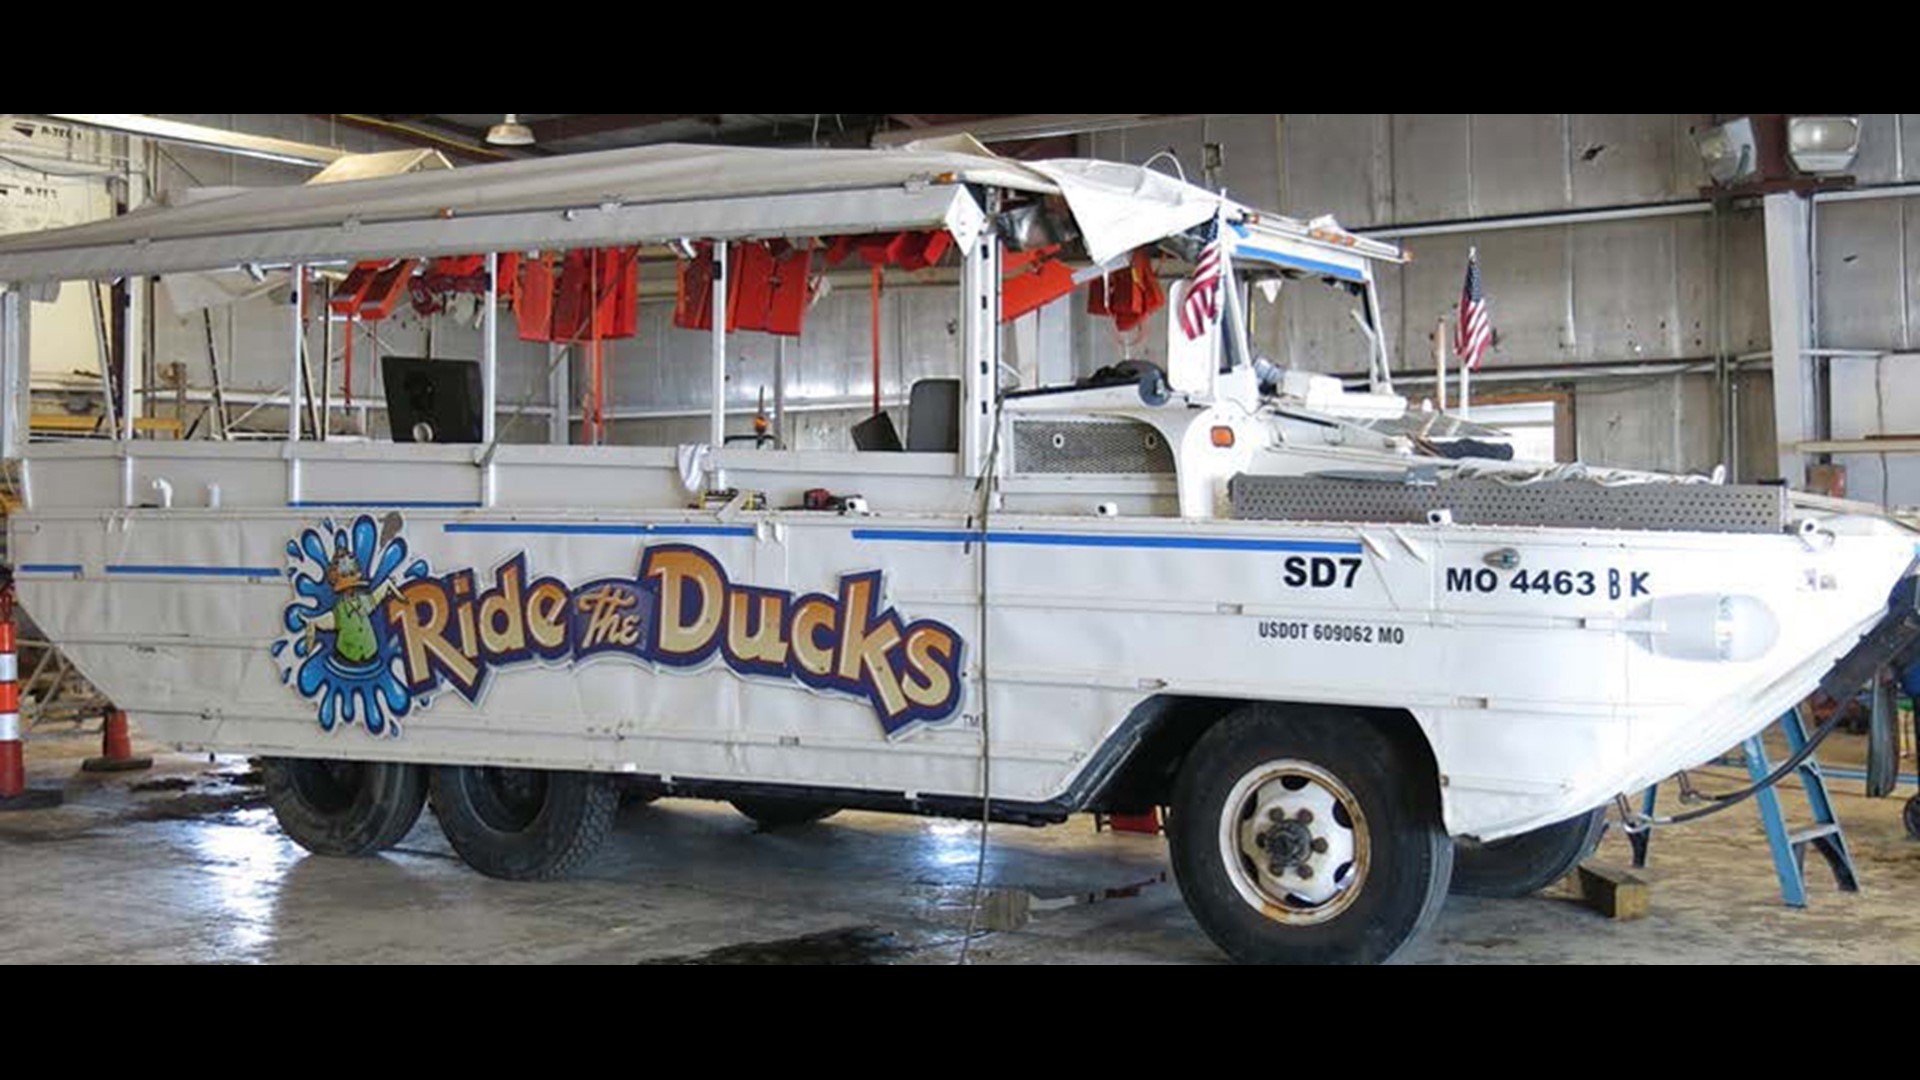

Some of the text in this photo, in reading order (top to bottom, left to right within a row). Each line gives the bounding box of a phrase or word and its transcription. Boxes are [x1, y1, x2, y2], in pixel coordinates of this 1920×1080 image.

[1283, 556, 1362, 588] SD7
[1446, 567, 1498, 593] MO
[1510, 569, 1596, 596] 4463
[386, 548, 953, 718] Ride The Ducks
[1259, 622, 1405, 645] USDOT 609062 MO
